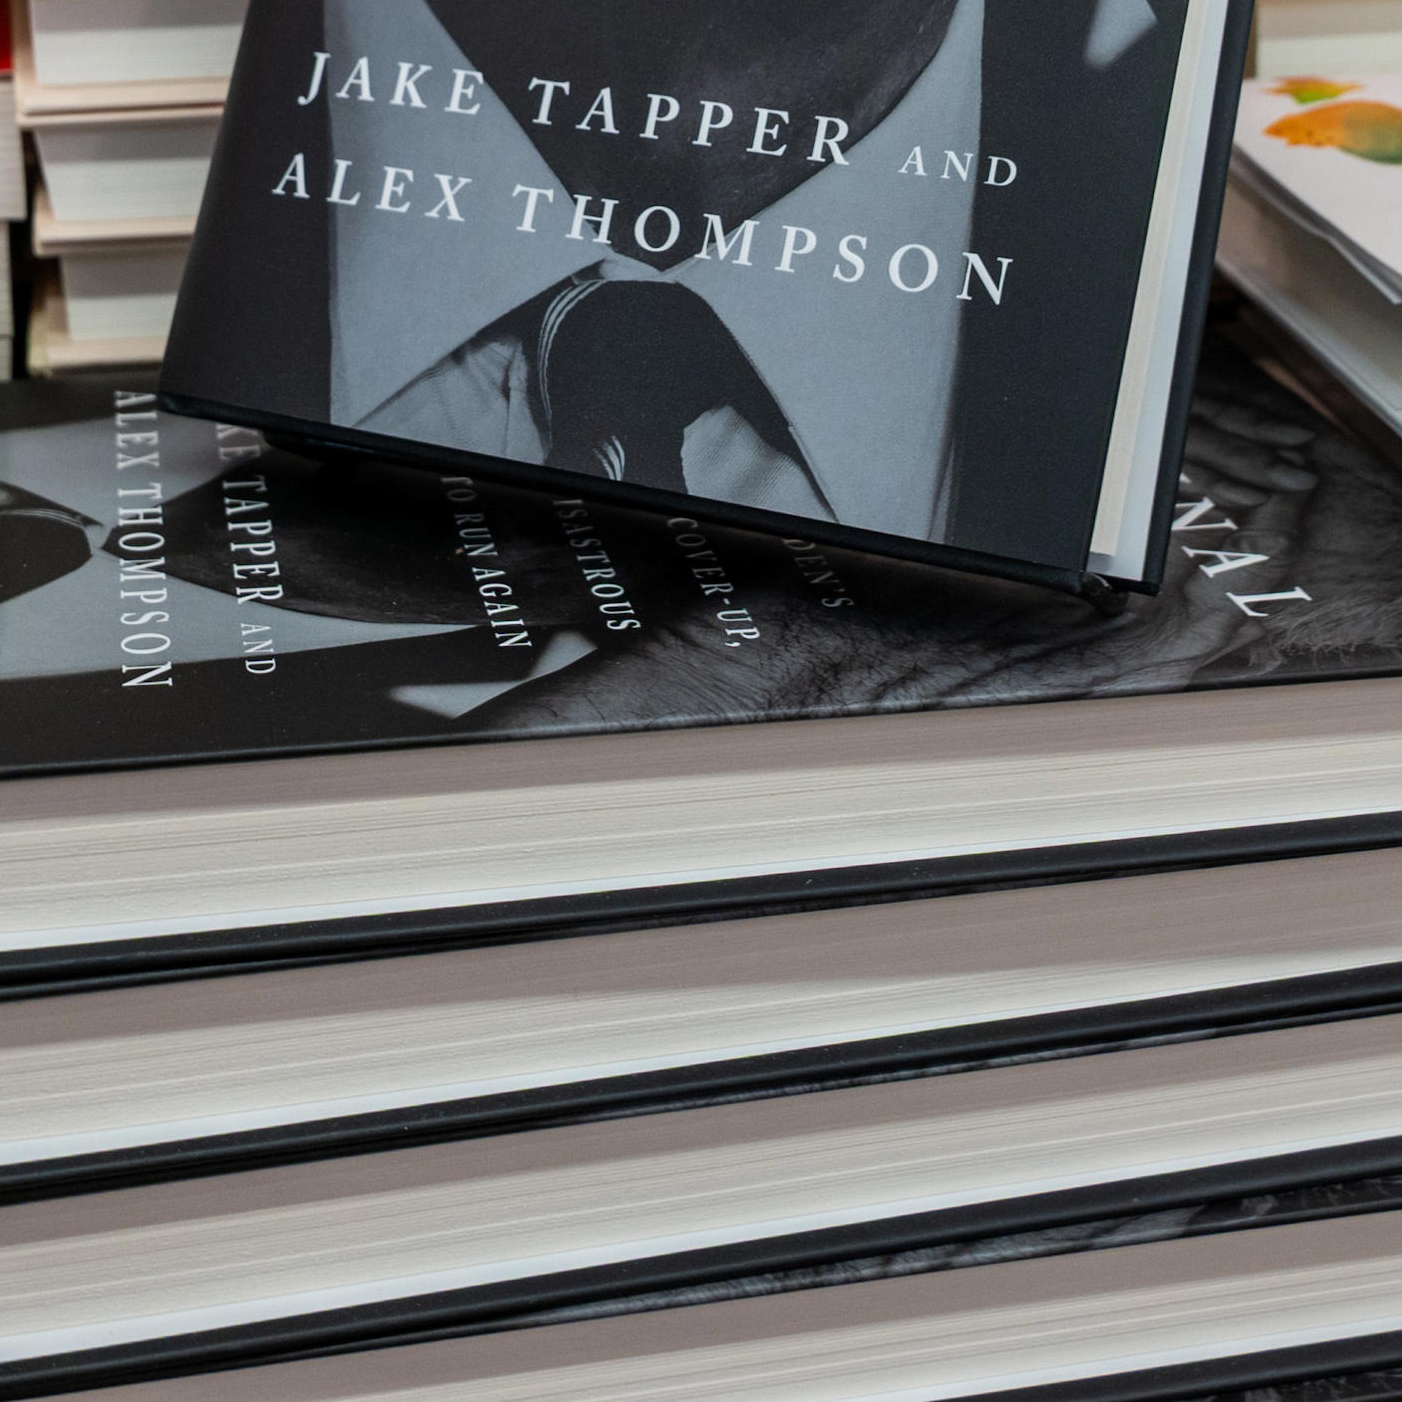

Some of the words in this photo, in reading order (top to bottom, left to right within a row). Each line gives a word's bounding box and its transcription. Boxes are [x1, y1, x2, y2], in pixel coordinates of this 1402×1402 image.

[297, 52, 485, 116] JAKE
[528, 77, 852, 166] TAPPER
[897, 144, 1020, 187] AND
[272, 153, 474, 223] ALEX
[511, 182, 1016, 306] THOMPSON
[113, 389, 160, 472] ALEX
[214, 422, 263, 462] KE
[115, 480, 175, 688] THOMPSON
[221, 474, 286, 606] TAPPER
[453, 512, 500, 558] RUN
[552, 498, 643, 632] ISASTROUS
[666, 516, 762, 649] COVER-UP,
[783, 538, 856, 609] DEN'S
[239, 621, 279, 676] AND
[470, 566, 535, 649] AGAIN
